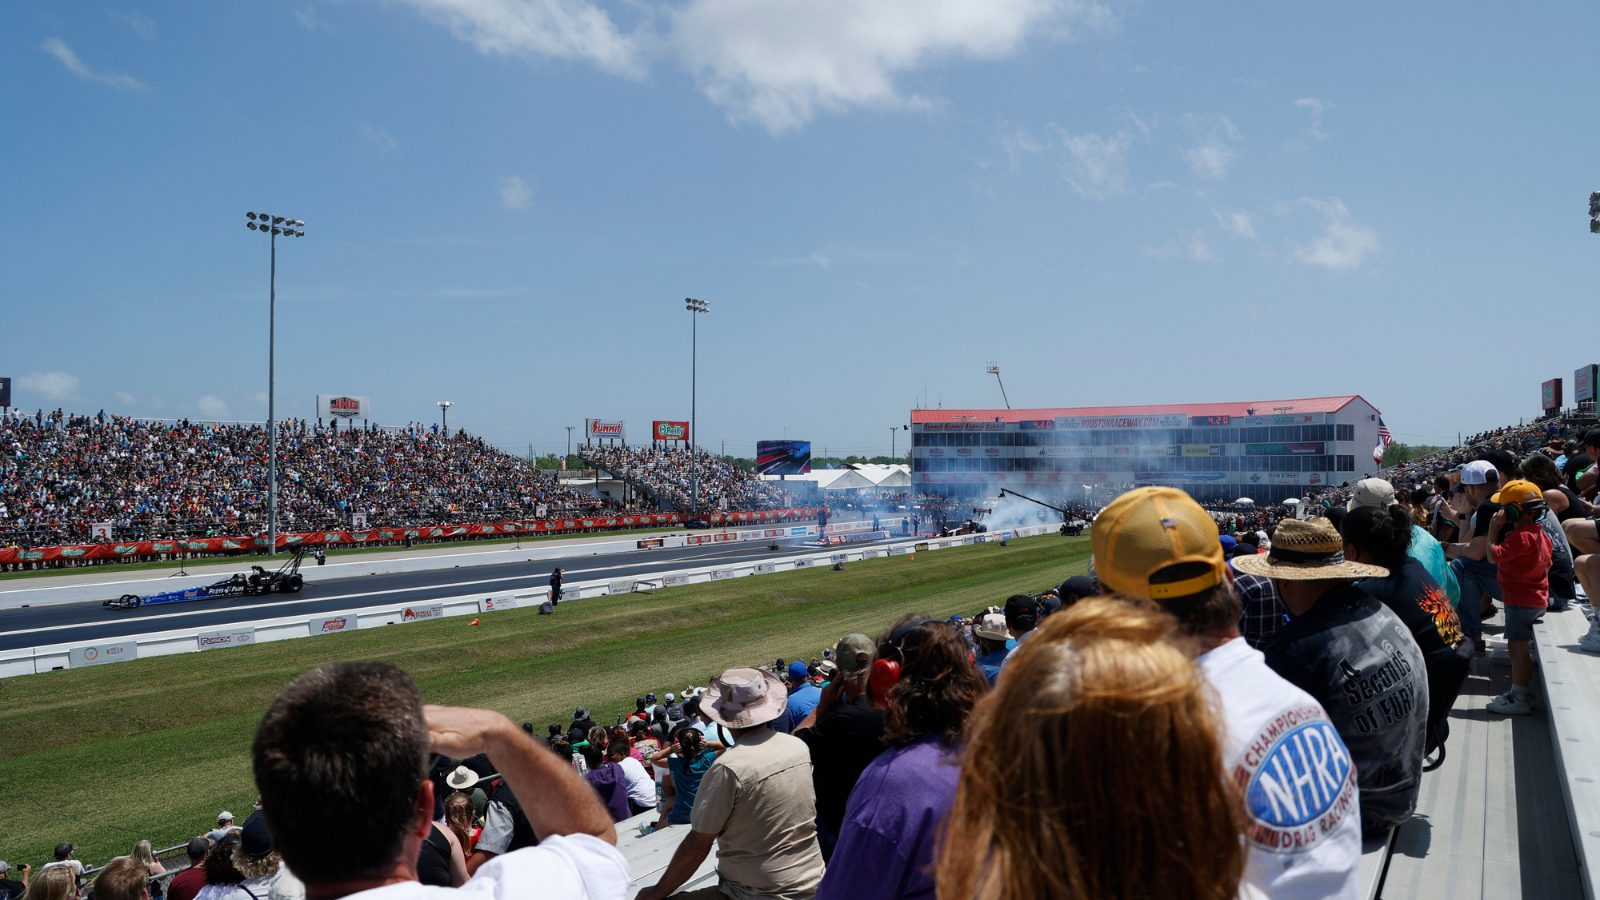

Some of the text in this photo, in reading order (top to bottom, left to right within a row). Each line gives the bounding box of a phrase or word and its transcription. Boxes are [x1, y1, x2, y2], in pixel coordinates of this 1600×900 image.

[1080, 416, 1159, 428] HOUSTONRACEWAY.COM
[659, 424, 685, 436] O'Reilly
[98, 527, 107, 538] 3
[1259, 724, 1348, 824] NHRA
[1281, 784, 1353, 849] DRAG RACING
